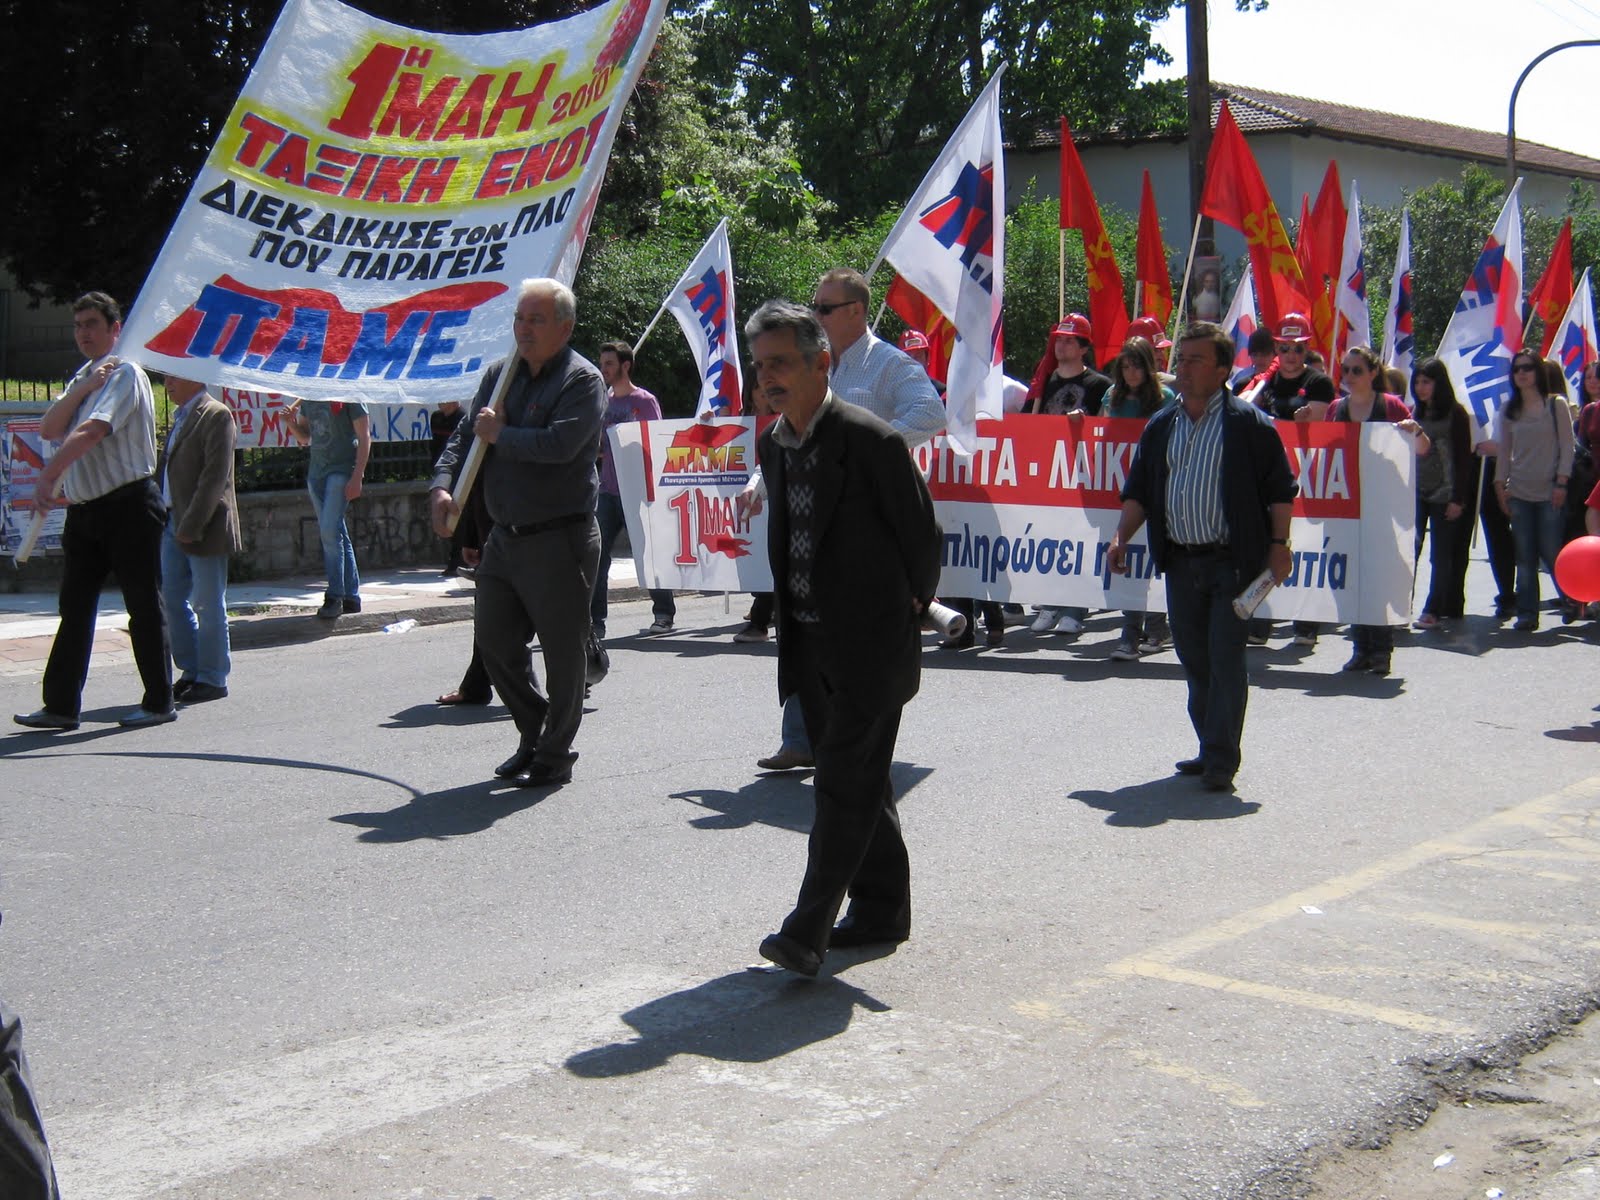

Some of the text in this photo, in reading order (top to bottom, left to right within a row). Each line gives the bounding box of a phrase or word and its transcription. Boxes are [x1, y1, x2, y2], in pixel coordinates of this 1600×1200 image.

[376, 62, 556, 142] ΜΑΗ
[235, 112, 460, 204] ΤΑΞΙΚΗ
[200, 179, 452, 250] ΔΙΕΚΔΙΚΗΣΕ
[249, 230, 508, 281] ΠΟΥ ΠΑΡΑΓΕΙΣ
[909, 435, 1018, 487] ΟΤΗΤΑ
[1048, 426, 1138, 492] ΛΑΪΚ
[1291, 447, 1351, 500] ΧΙΑ
[941, 523, 1084, 584] πληρώσει
